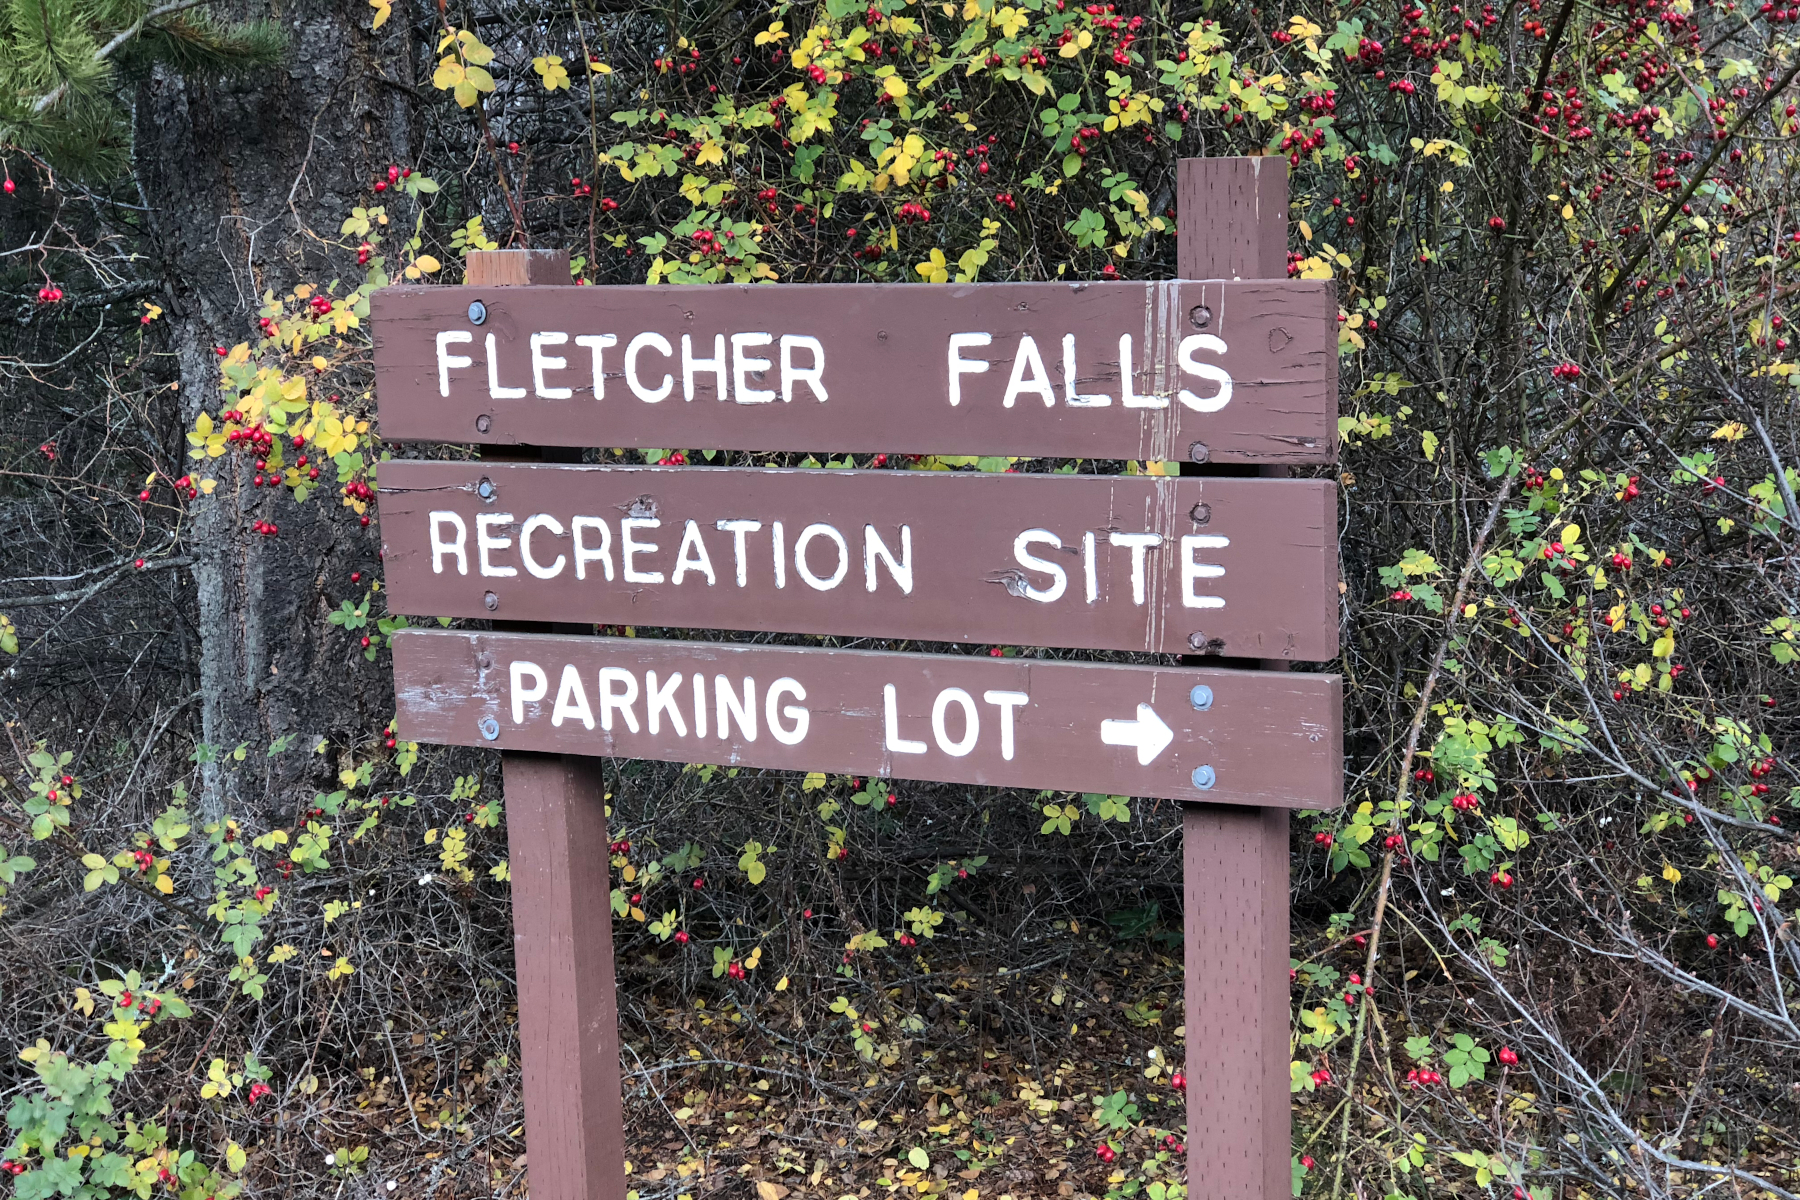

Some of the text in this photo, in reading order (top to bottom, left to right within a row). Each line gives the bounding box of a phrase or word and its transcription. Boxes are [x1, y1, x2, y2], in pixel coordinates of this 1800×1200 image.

[436, 331, 1234, 413] FLETCHER FALLS
[429, 511, 1231, 609] RECREATION SITE
[509, 661, 1029, 762] PARKING LOT
